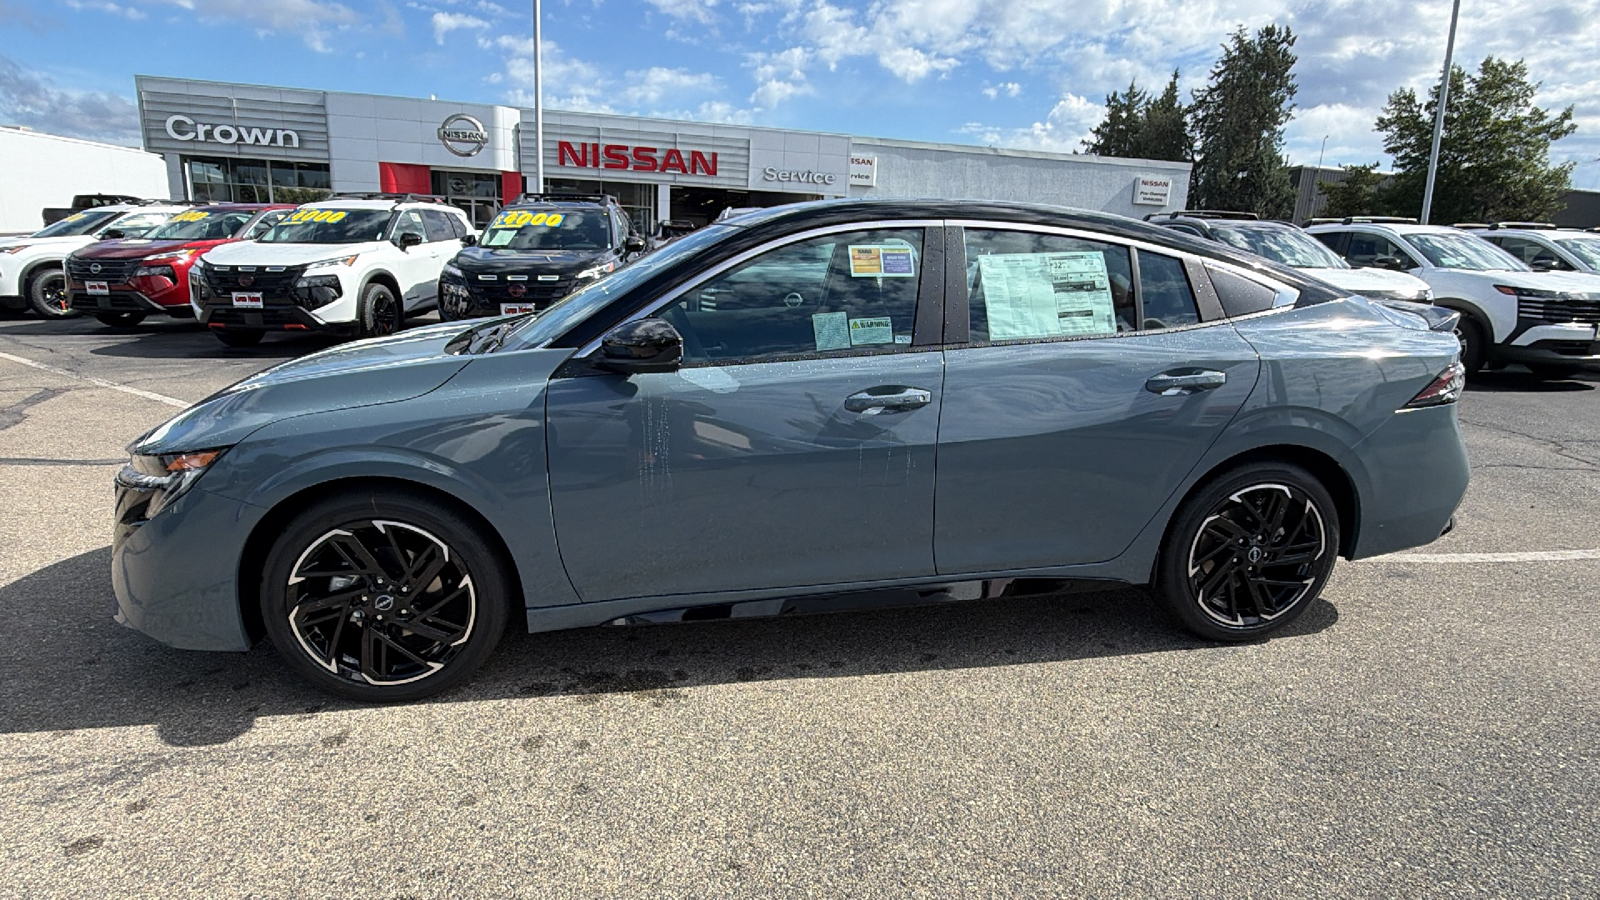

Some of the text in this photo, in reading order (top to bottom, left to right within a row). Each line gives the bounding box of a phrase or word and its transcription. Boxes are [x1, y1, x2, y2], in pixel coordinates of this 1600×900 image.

[165, 114, 299, 148] Crown
[443, 130, 484, 140] NISSAN
[558, 140, 718, 176] NISSAN
[763, 166, 836, 184] Service
